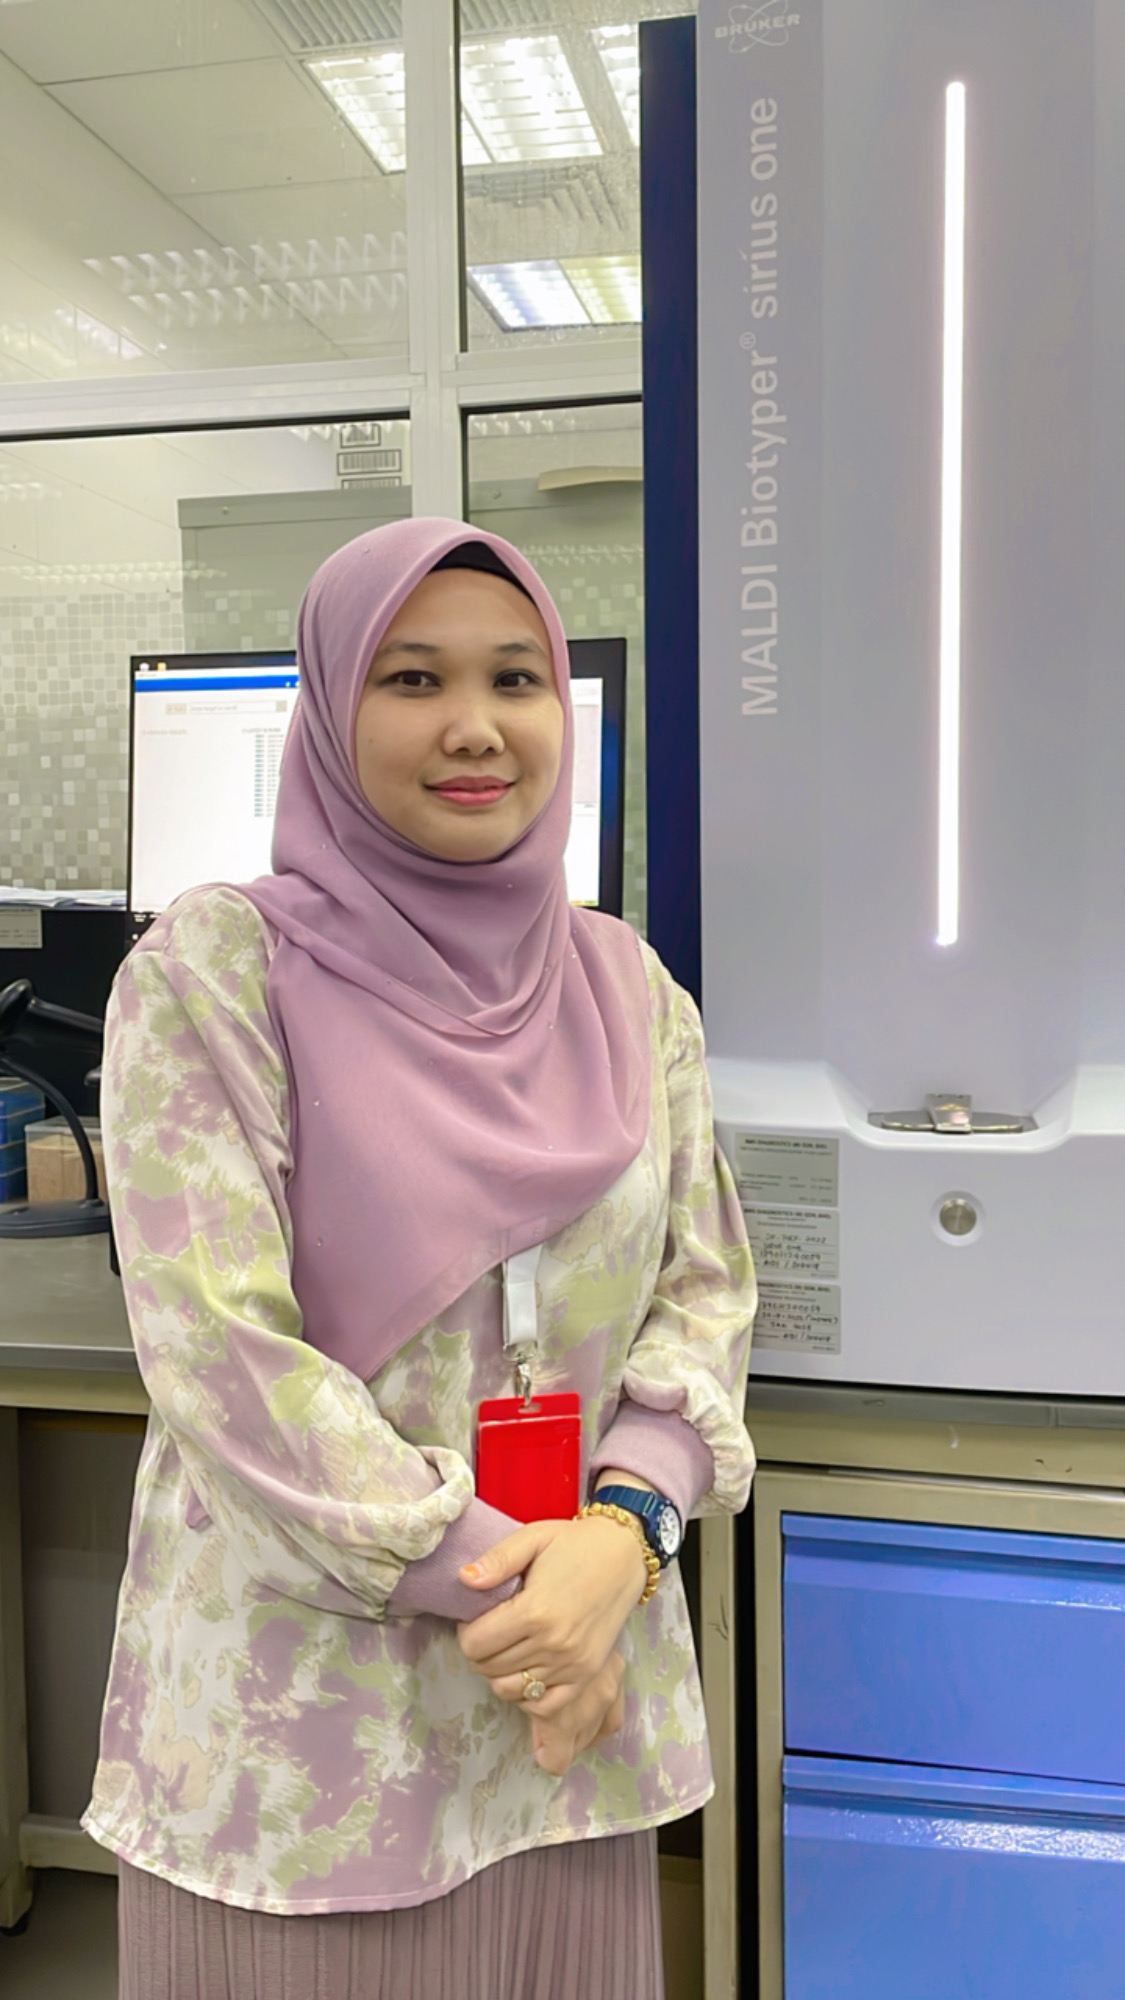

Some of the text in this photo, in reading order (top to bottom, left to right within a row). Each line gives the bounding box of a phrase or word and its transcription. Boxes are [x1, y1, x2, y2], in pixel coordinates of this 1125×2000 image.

[714, 13, 801, 38] BRUKER
[750, 98, 778, 181] one
[740, 564, 777, 716] MALDI
